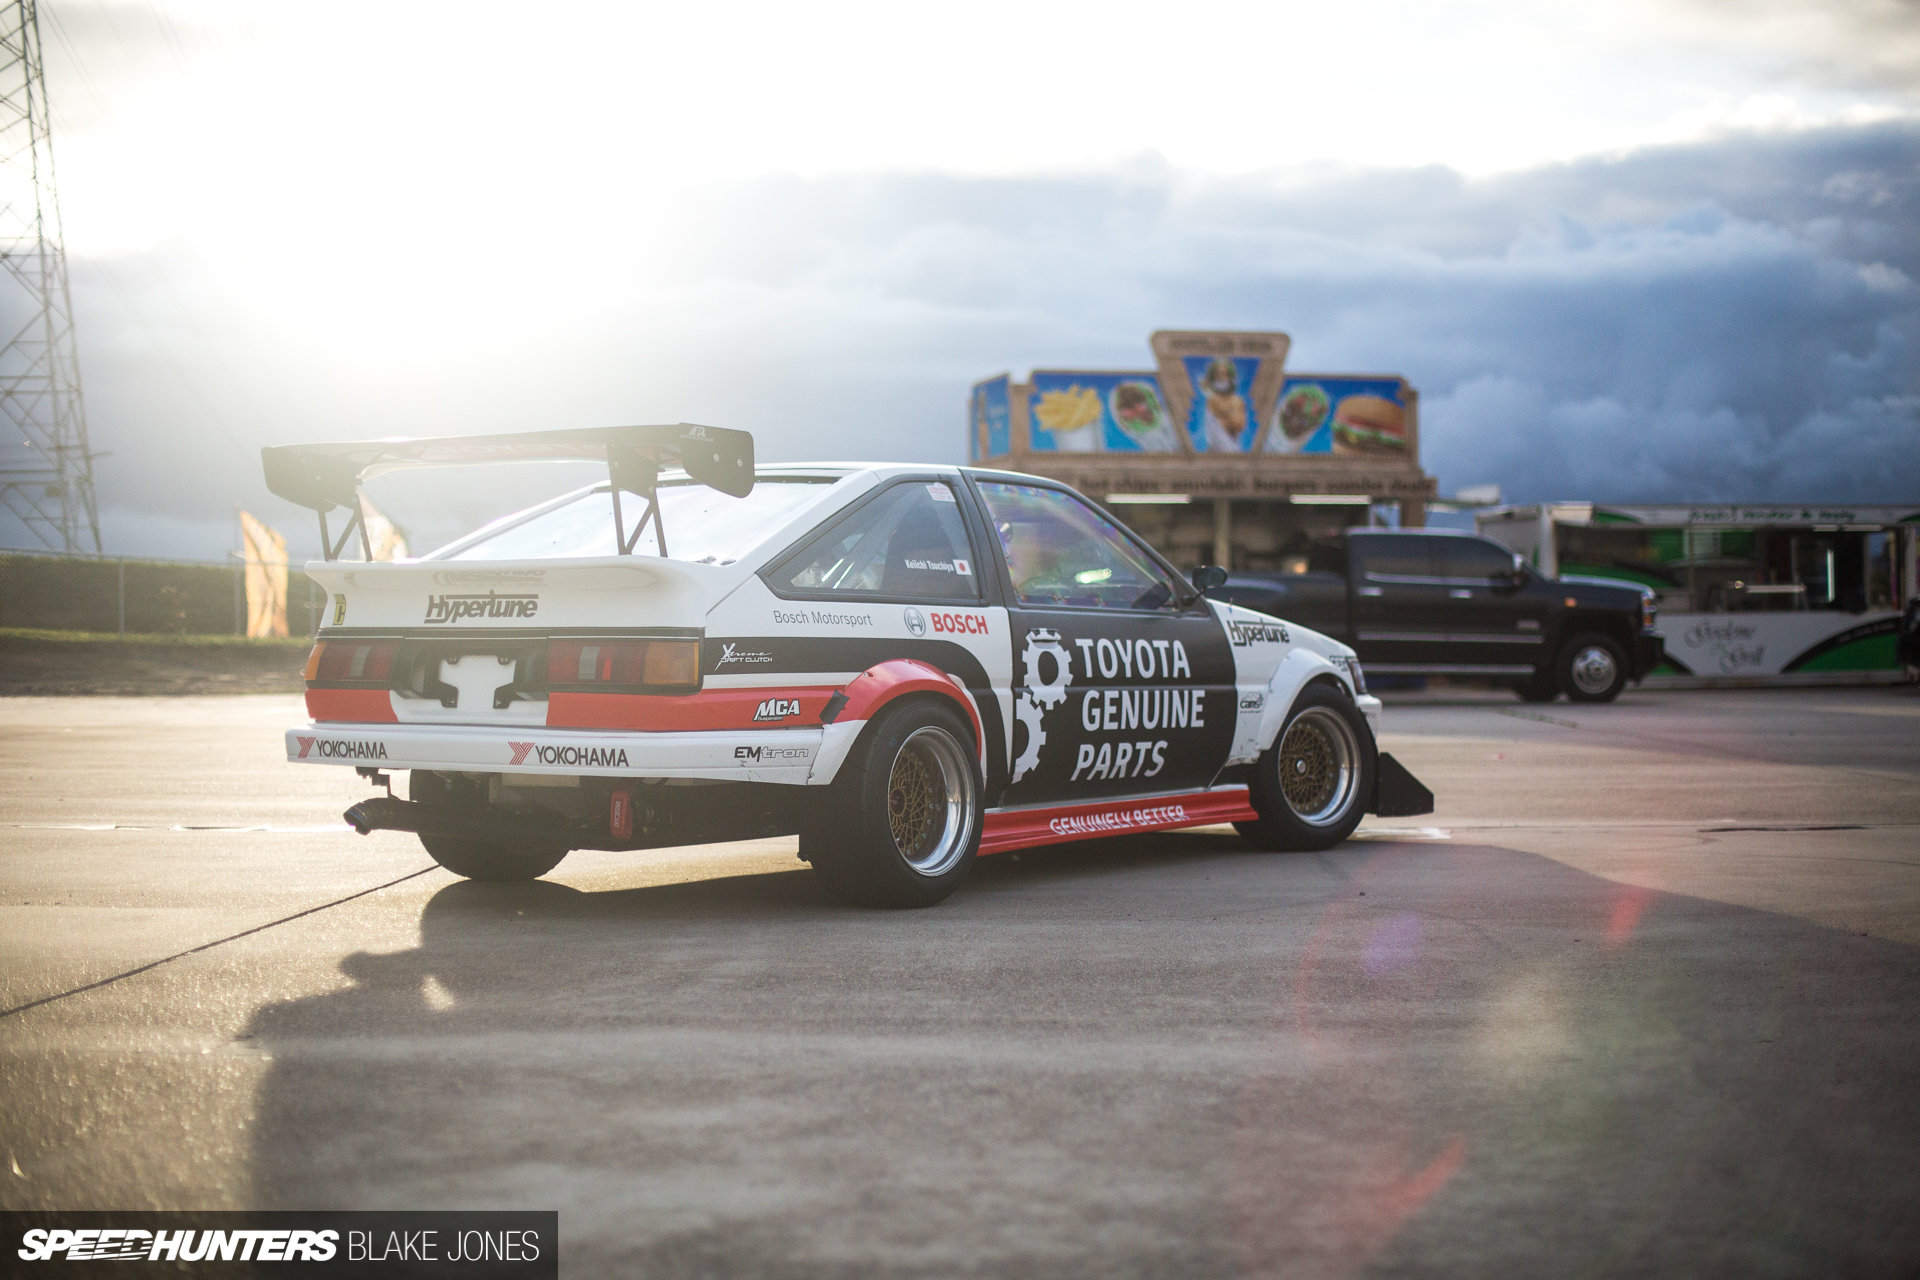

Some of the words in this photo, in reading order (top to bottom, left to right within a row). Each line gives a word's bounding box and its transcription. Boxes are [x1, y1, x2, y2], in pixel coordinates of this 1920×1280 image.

[424, 589, 539, 624] Hypertune
[773, 611, 809, 625] Bosch
[811, 611, 873, 628] Motorsport
[930, 613, 989, 635] BOSCH
[1226, 617, 1290, 647] Hypertune
[1075, 638, 1191, 679] TOYOTA
[753, 698, 801, 721] MCA
[1082, 689, 1205, 732] GENUINE
[316, 740, 388, 759] YOKOHAMA
[535, 745, 629, 767] YOKOHAMA
[1070, 740, 1168, 782] PARTS
[1050, 811, 1134, 835] GENUINELY
[1133, 805, 1190, 825] BETTER
